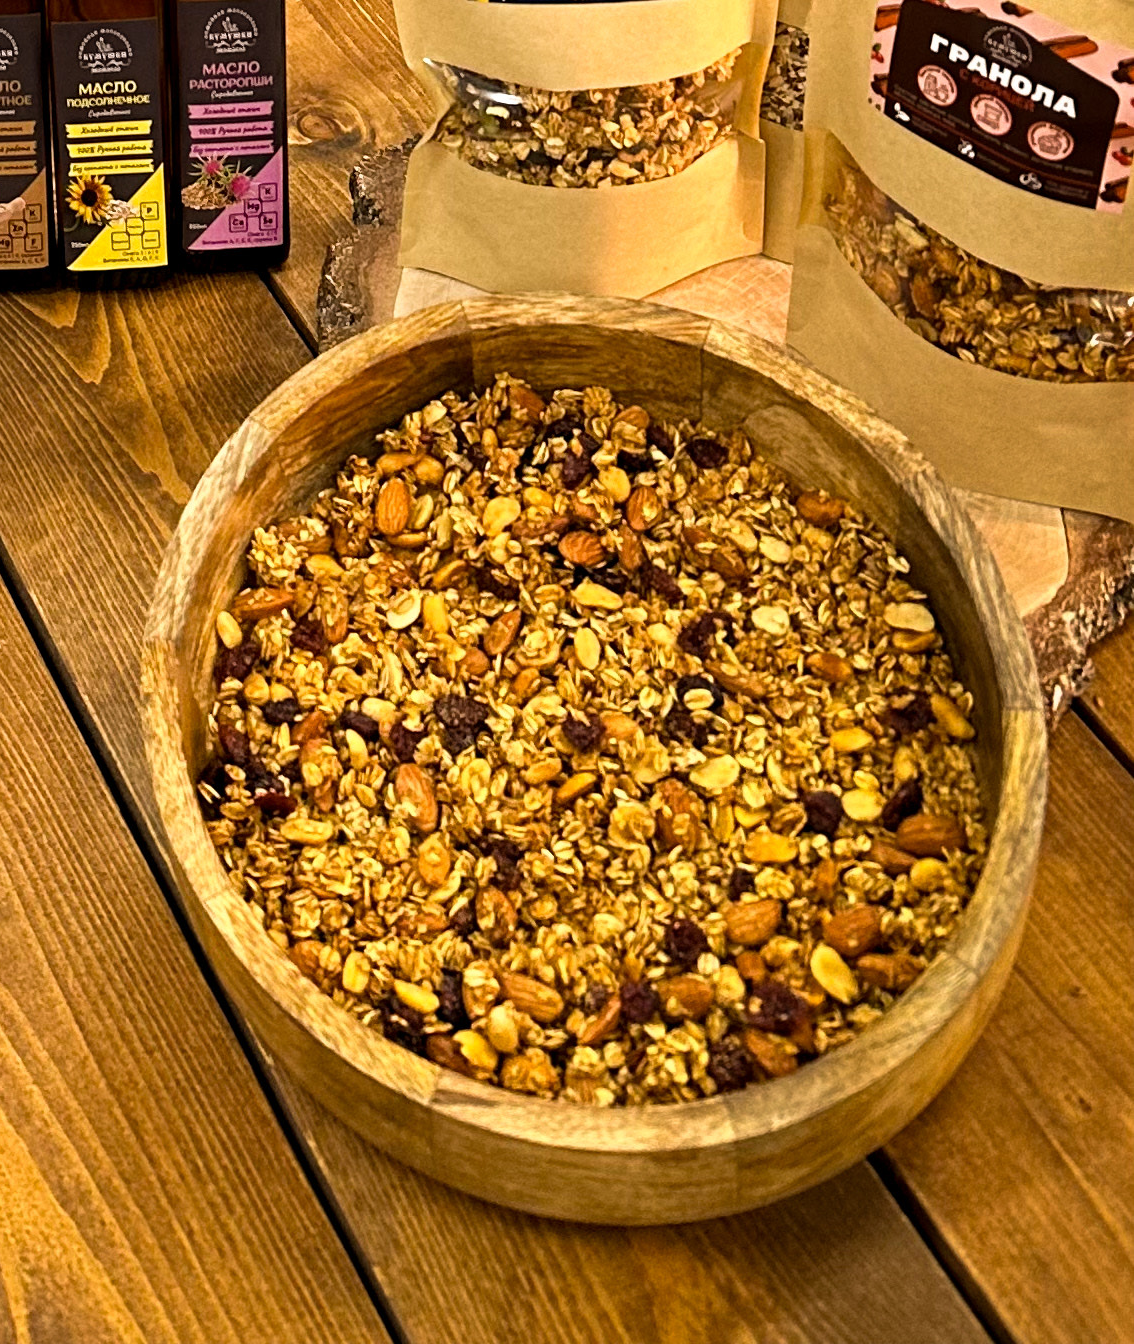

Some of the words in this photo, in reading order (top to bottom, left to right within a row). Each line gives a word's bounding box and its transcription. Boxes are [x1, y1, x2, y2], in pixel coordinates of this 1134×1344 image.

[202, 60, 260, 76] МАСЛО
[930, 32, 1077, 119] ГРАНОЛА
[78, 80, 137, 96] МАСЛО
[189, 75, 274, 90] РАСТОРОПШИ
[66, 94, 150, 109] ПОДСОЛНЕЧНОЕ
